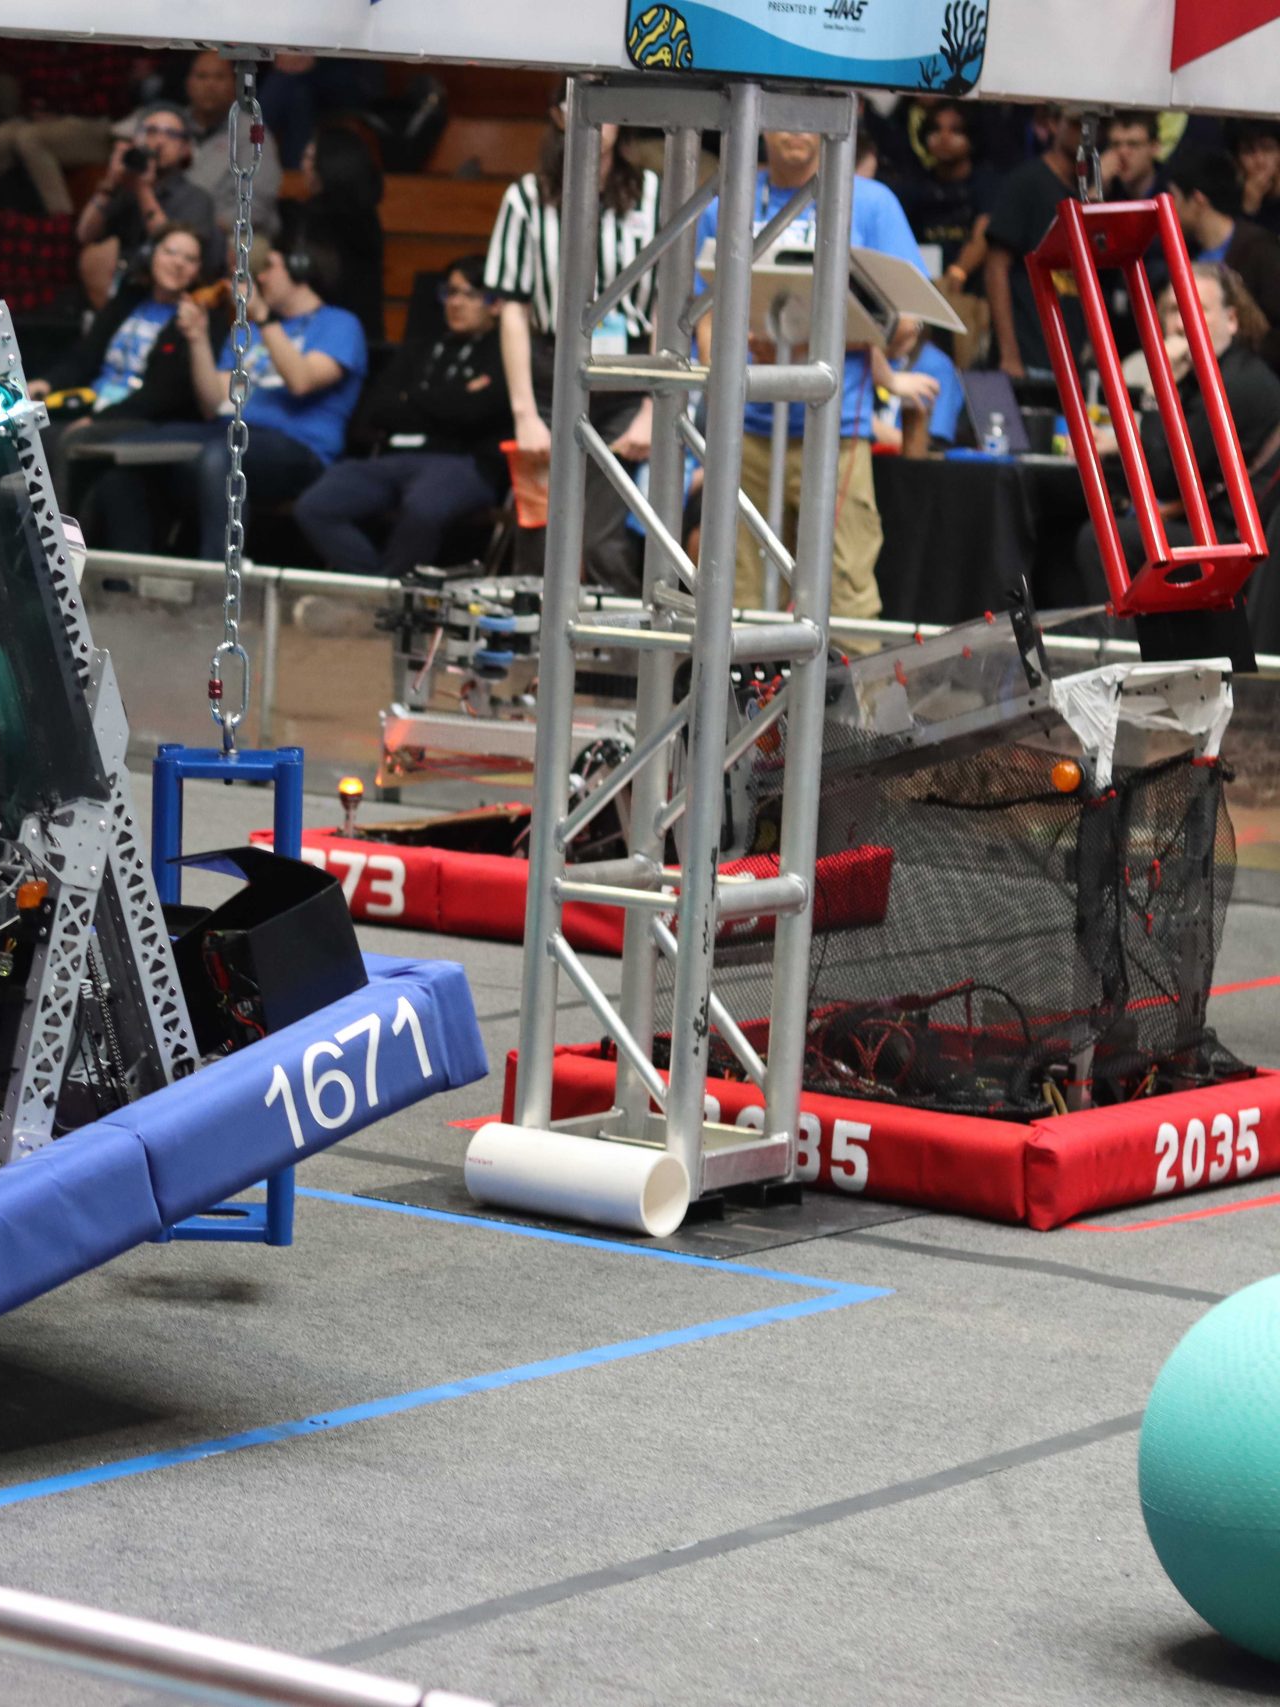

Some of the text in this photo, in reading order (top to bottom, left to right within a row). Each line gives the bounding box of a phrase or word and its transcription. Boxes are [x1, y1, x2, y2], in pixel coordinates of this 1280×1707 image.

[767, 0, 817, 15] PRESENTED BY
[301, 847, 406, 917] 73
[264, 995, 433, 1149] 1671
[1151, 1106, 1261, 1196] 2035
